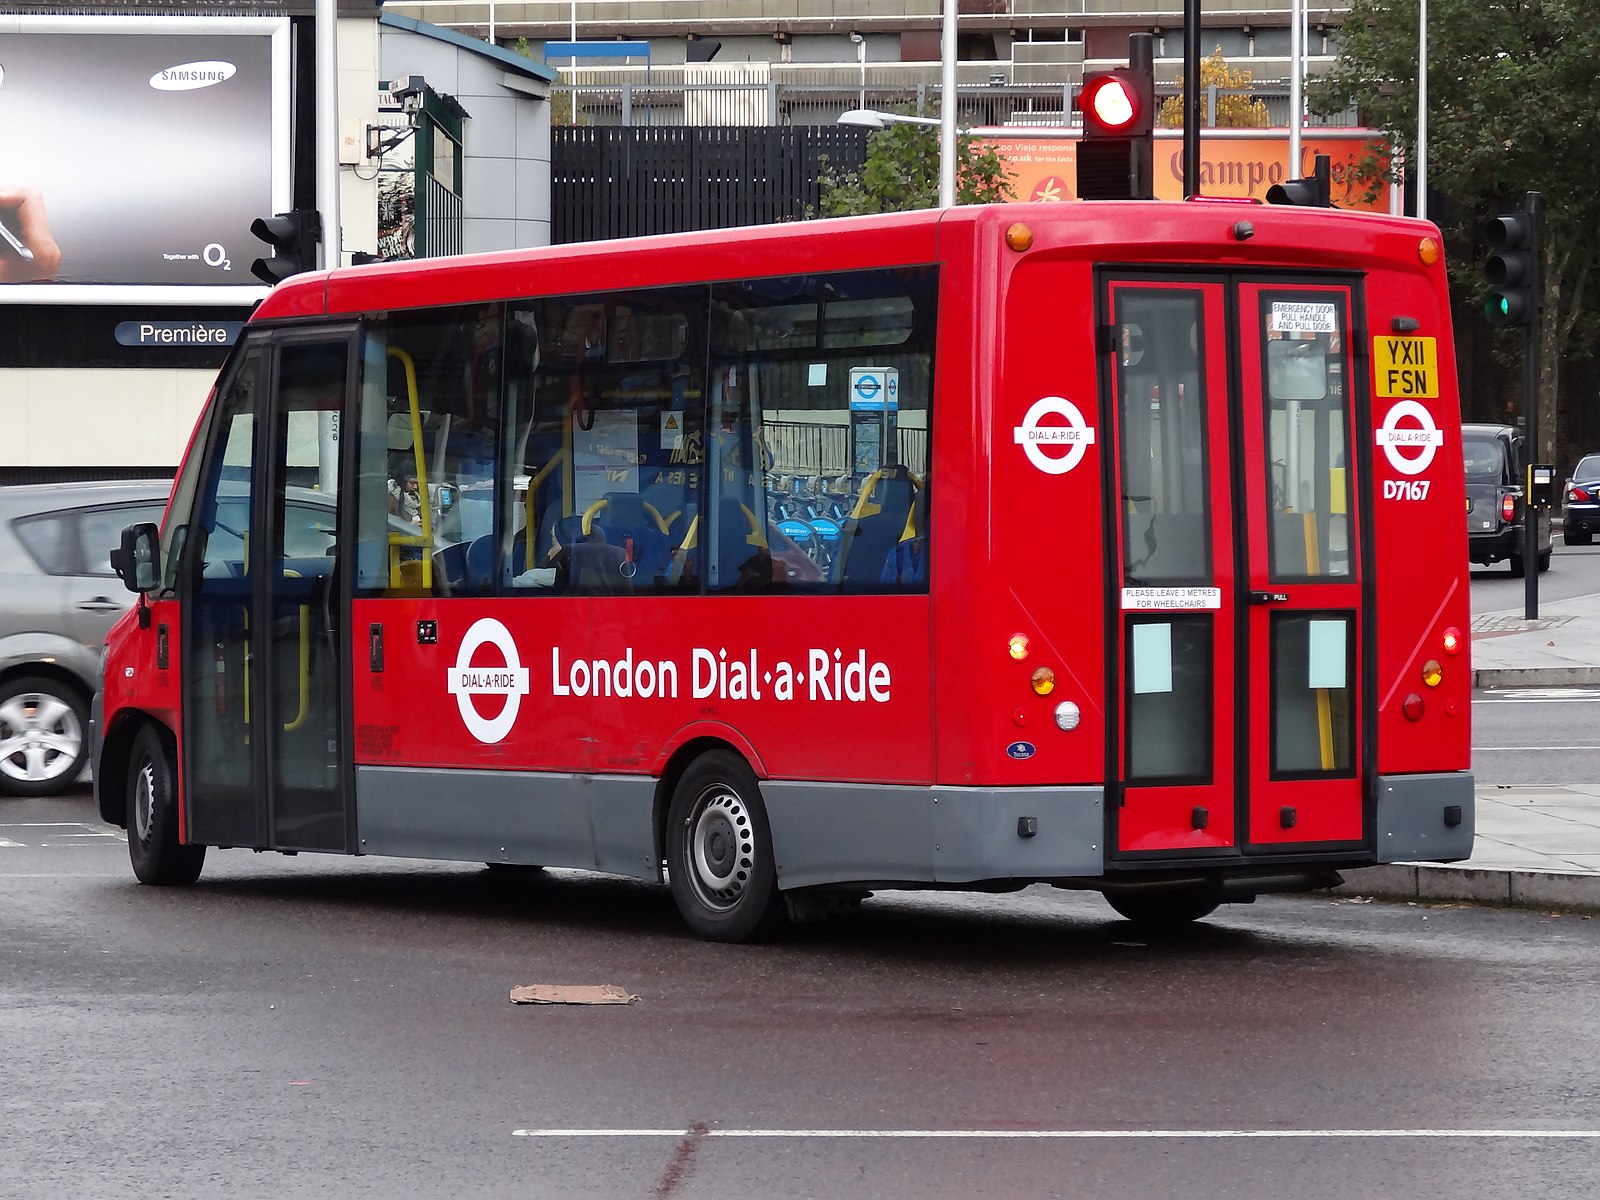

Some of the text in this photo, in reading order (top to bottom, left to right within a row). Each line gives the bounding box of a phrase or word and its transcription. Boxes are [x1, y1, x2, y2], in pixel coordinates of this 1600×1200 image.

[161, 70, 225, 81] SAMSUNG
[1015, 143, 1037, 152] Viejo
[163, 253, 187, 261] Together
[1274, 303, 1334, 314] EMERGENCY DOOR
[1281, 312, 1327, 322] PULL HANDLE
[1278, 321, 1331, 331] AND PULL DOOR
[140, 324, 227, 343] Première
[1387, 340, 1424, 365] YX11
[1388, 370, 1427, 394] FSN
[1383, 480, 1430, 501] D7167
[1126, 588, 1217, 597] PLEASE LEAVE 3 METRES
[1136, 600, 1207, 608] FOR WHEELCHAIRS
[552, 646, 678, 698] London
